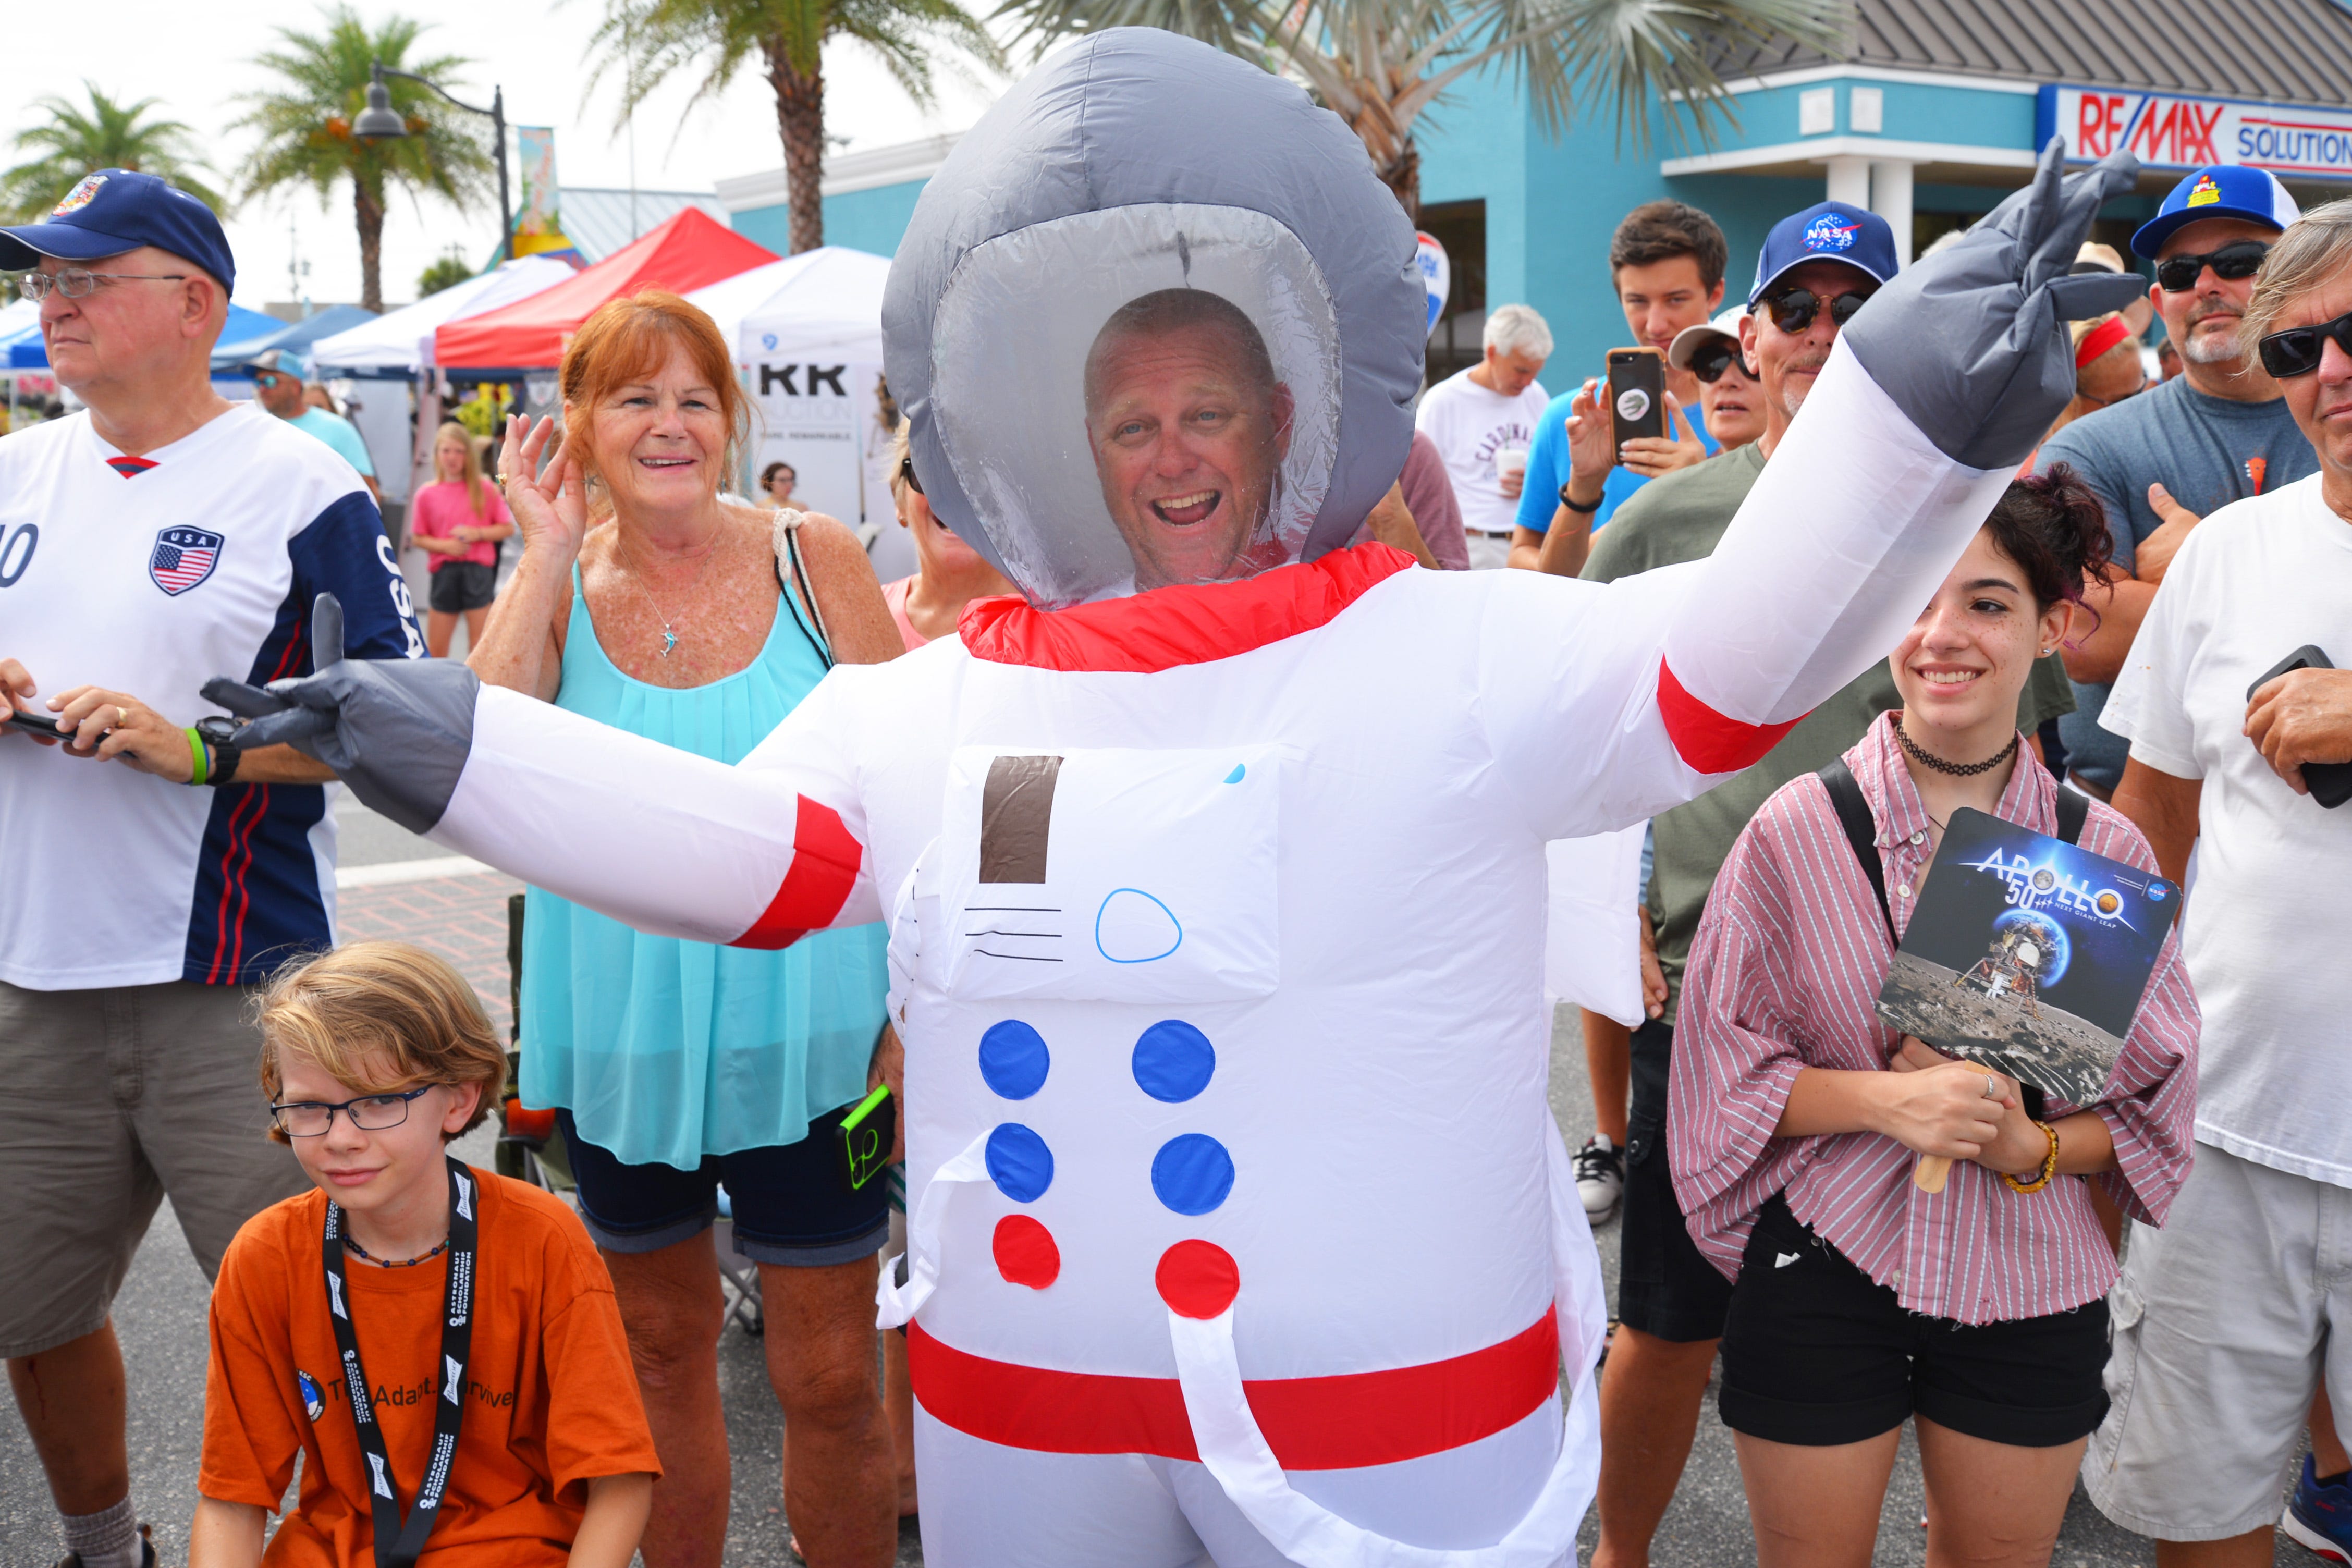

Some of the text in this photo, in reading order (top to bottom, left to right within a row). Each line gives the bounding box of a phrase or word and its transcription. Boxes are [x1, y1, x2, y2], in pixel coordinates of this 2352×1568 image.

[2079, 92, 2224, 166] RE/MAX
[1807, 227, 1853, 240] NASA
[170, 532, 207, 546] USA
[376, 534, 425, 659] USA
[1973, 847, 2125, 922] APOLLO
[2005, 877, 2034, 910] 50
[2054, 902, 2117, 929] NEXT GIANT LEAP
[451, 1252, 460, 1314] ASTRONAUT
[457, 1252, 466, 1314] SCHOLARSHIP
[462, 1252, 472, 1314] FOUNDATION
[345, 1363, 363, 1424] FOUNDATION
[349, 1363, 367, 1424] SCHOLARSHIP
[353, 1362, 372, 1423] ASTRONAUT
[447, 1361, 457, 1400] Budweiser
[372, 1456, 385, 1496] Budweiser
[424, 1432, 444, 1496] ASTRONAUT
[430, 1434, 449, 1497] SCHOLARSHIP
[434, 1435, 455, 1498] FOUNDATION
